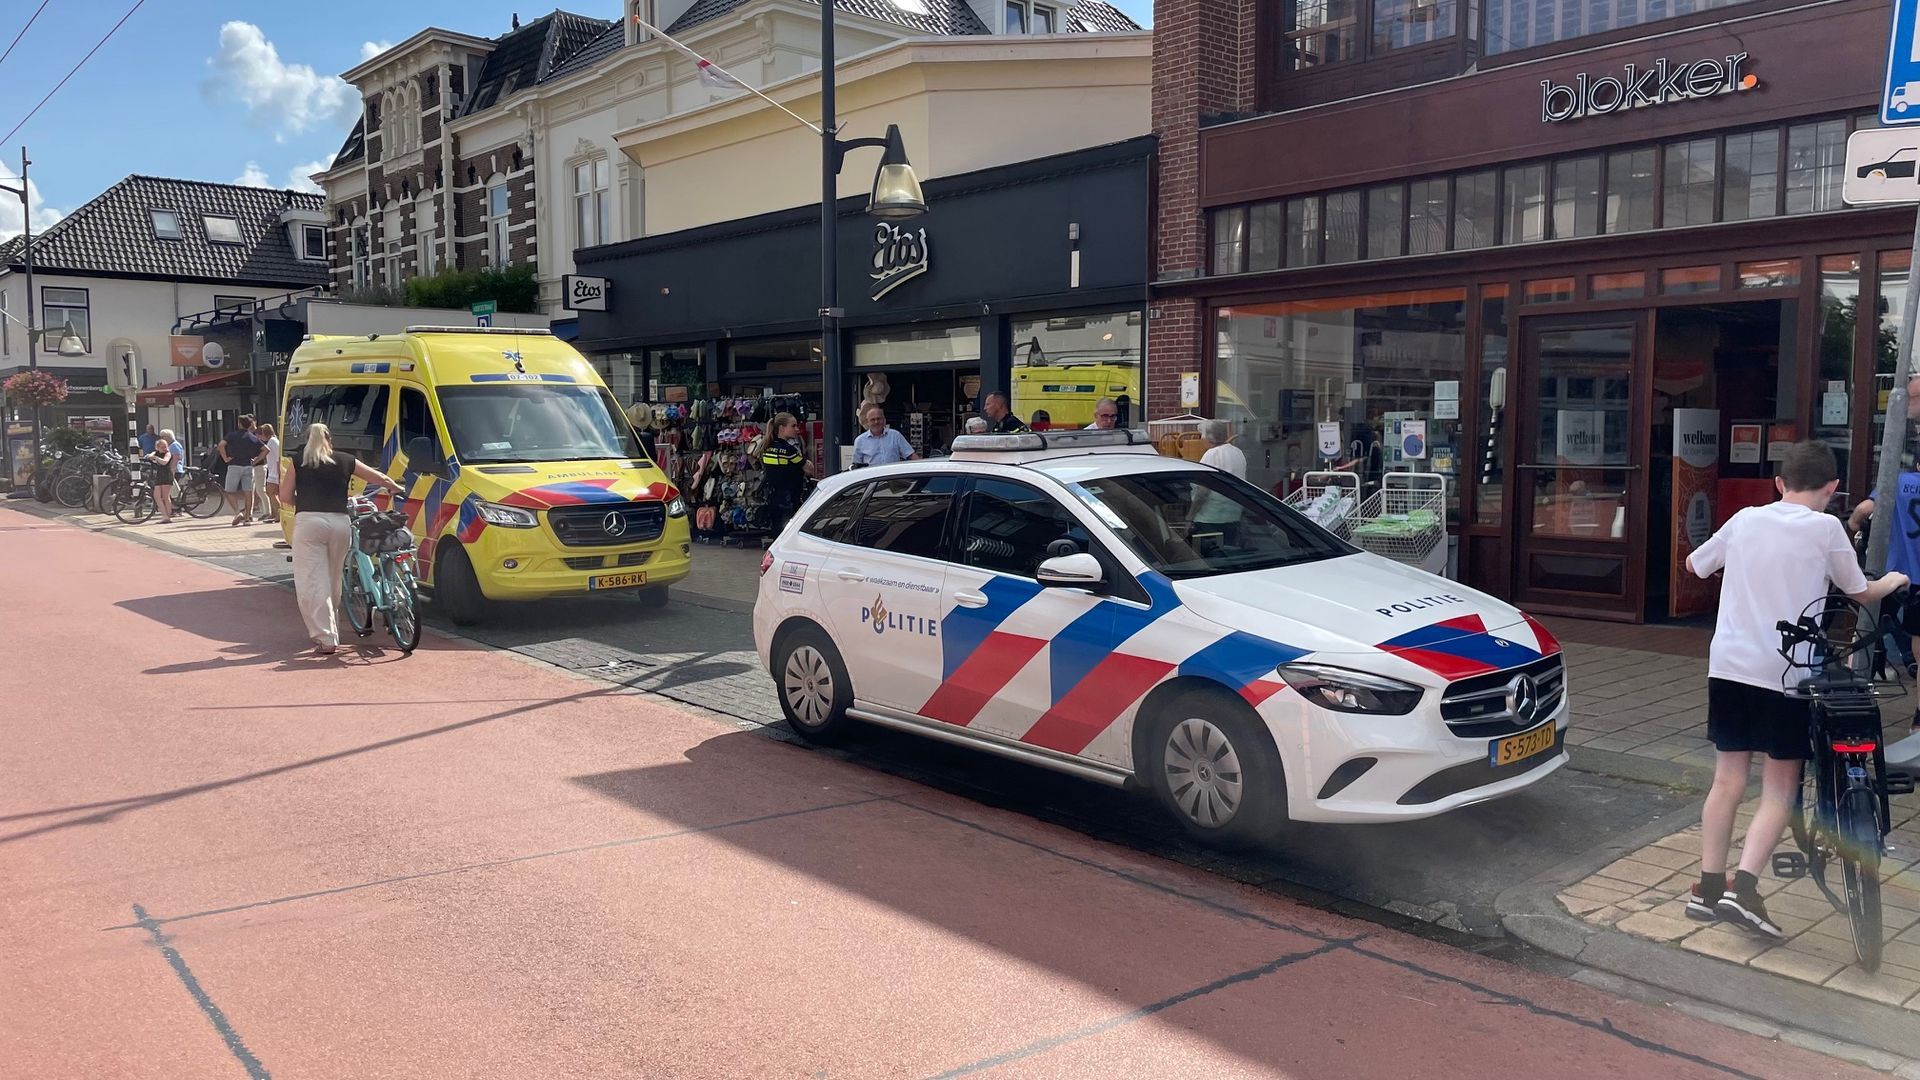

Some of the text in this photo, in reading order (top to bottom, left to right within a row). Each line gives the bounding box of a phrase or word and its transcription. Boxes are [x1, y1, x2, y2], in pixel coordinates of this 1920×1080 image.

[870, 222, 928, 280] Etos
[574, 280, 601, 297] Etos
[1683, 430, 1717, 446] welkom
[548, 471, 626, 479] AMBULANCE
[1375, 594, 1465, 618] POLITIE
[862, 606, 937, 637] POLITIE
